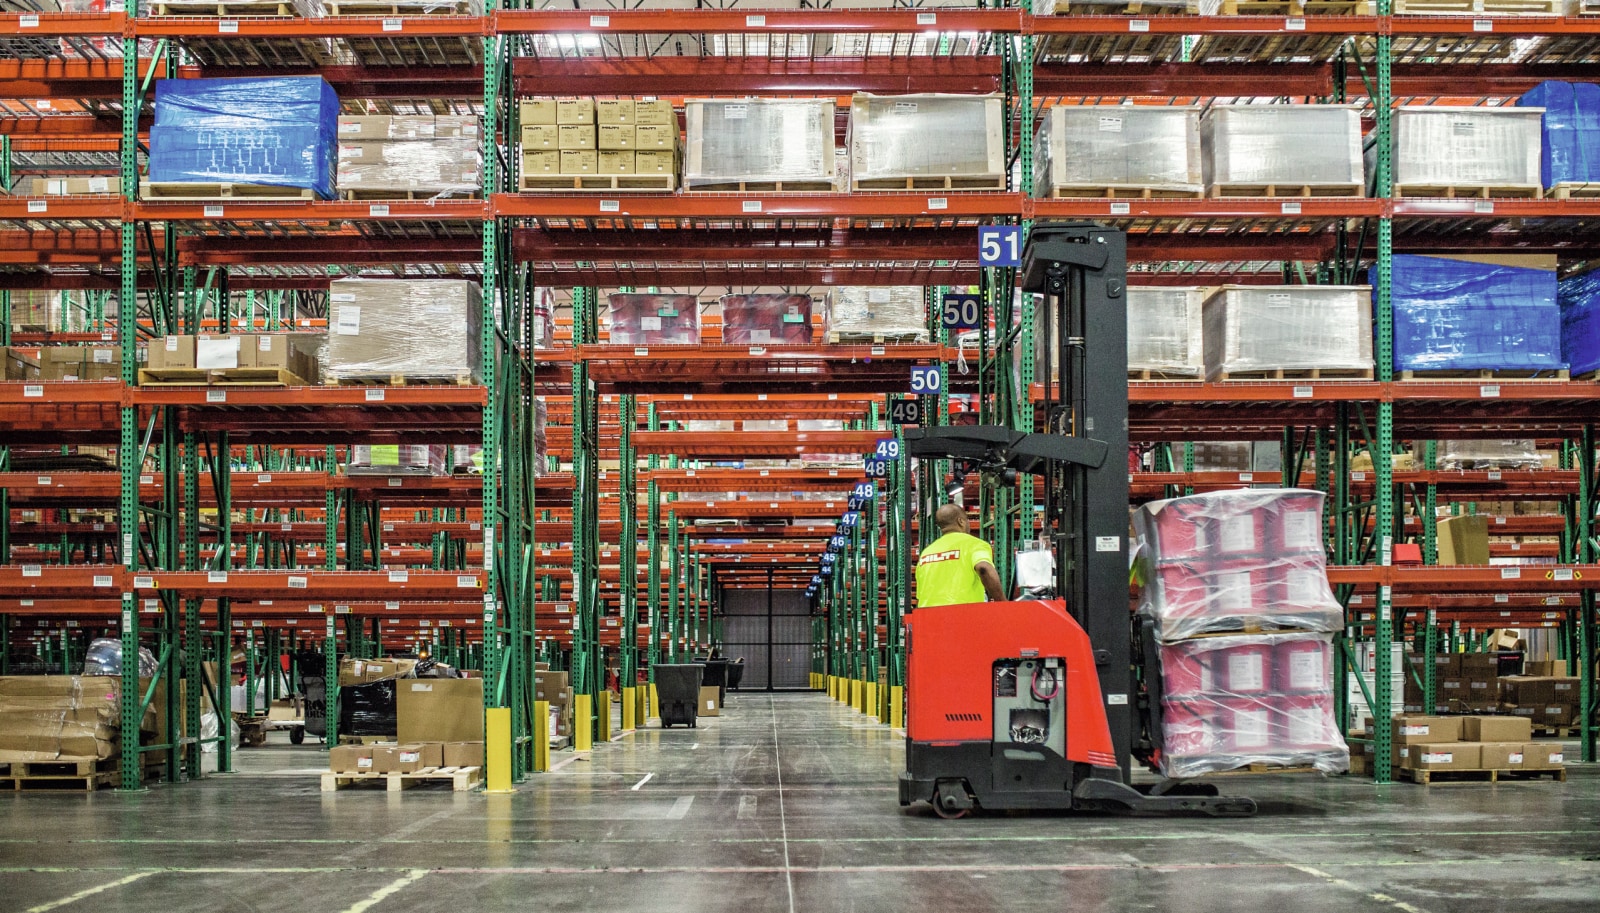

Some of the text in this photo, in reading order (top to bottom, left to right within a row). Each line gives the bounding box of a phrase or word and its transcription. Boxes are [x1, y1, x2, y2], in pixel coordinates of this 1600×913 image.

[981, 231, 1018, 261] 51
[944, 300, 978, 324] 50
[911, 370, 940, 390] 50
[893, 402, 918, 421] 49
[876, 442, 899, 457] 49
[866, 462, 885, 476] 48
[855, 484, 874, 497] 48
[848, 498, 864, 510] 47
[842, 513, 858, 524] 47
[837, 525, 850, 535] 46
[832, 536, 844, 546] 46
[920, 550, 960, 566] HILTI
